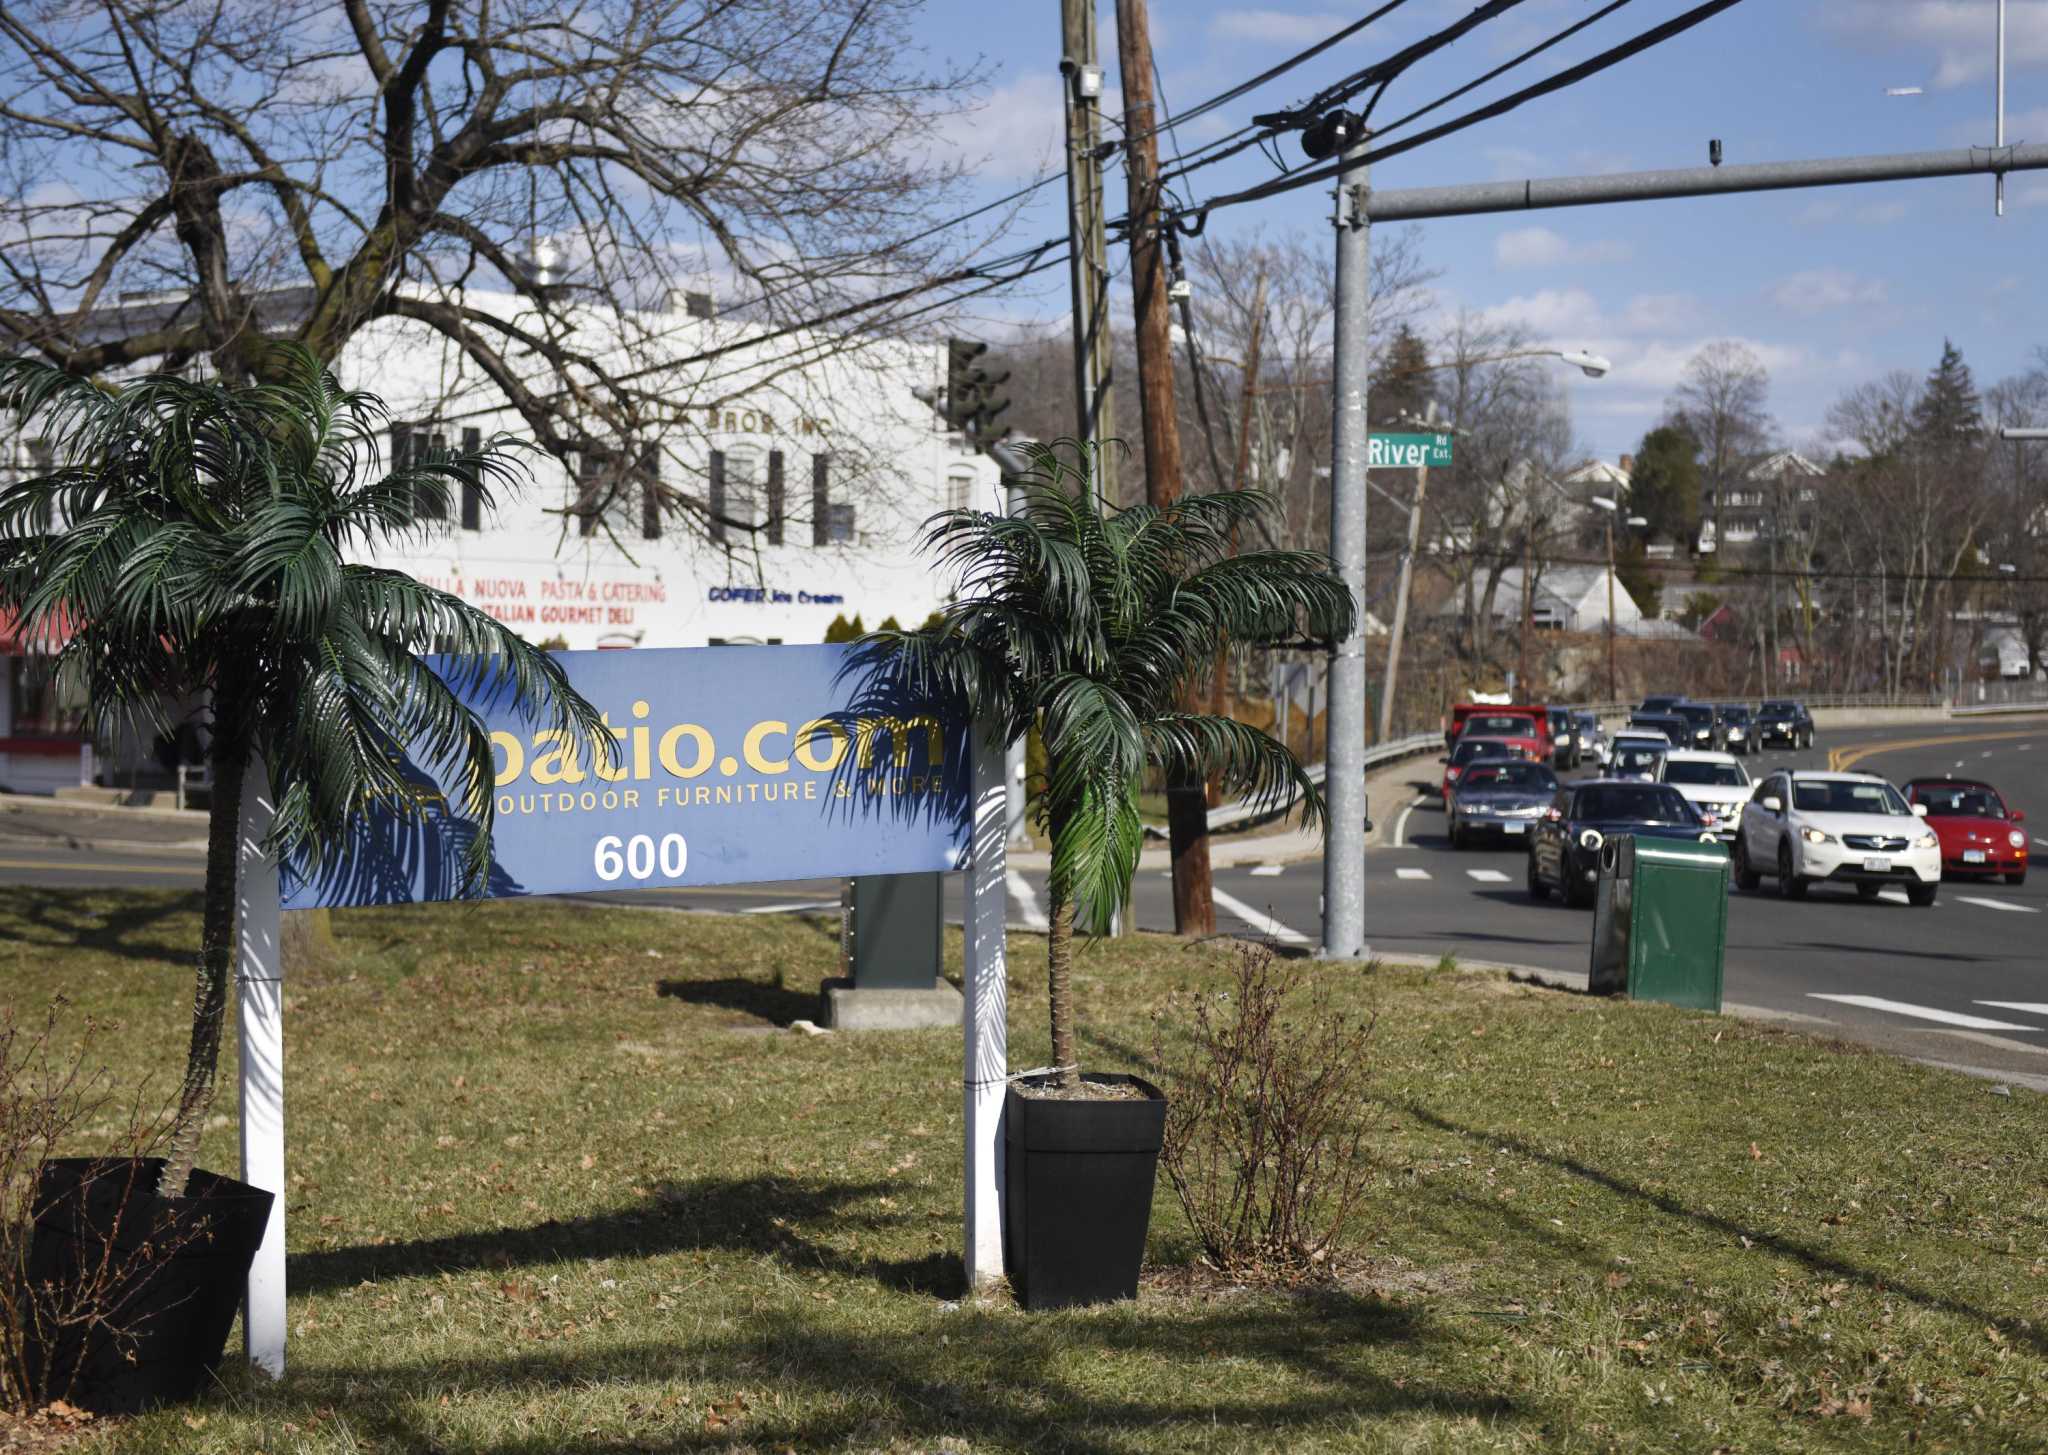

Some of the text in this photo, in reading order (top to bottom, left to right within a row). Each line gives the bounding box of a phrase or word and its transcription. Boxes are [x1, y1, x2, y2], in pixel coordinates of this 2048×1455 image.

[1368, 434, 1447, 465] River Rd
[475, 579, 527, 599] NUOVA
[541, 579, 583, 600] PASTA
[586, 581, 597, 600] &
[602, 580, 667, 602] CATERING
[541, 605, 602, 624] GOURMET
[607, 606, 635, 625] DELI
[498, 775, 944, 815] OUTDOOR FURNITURE & MORE
[594, 832, 688, 881] 600
